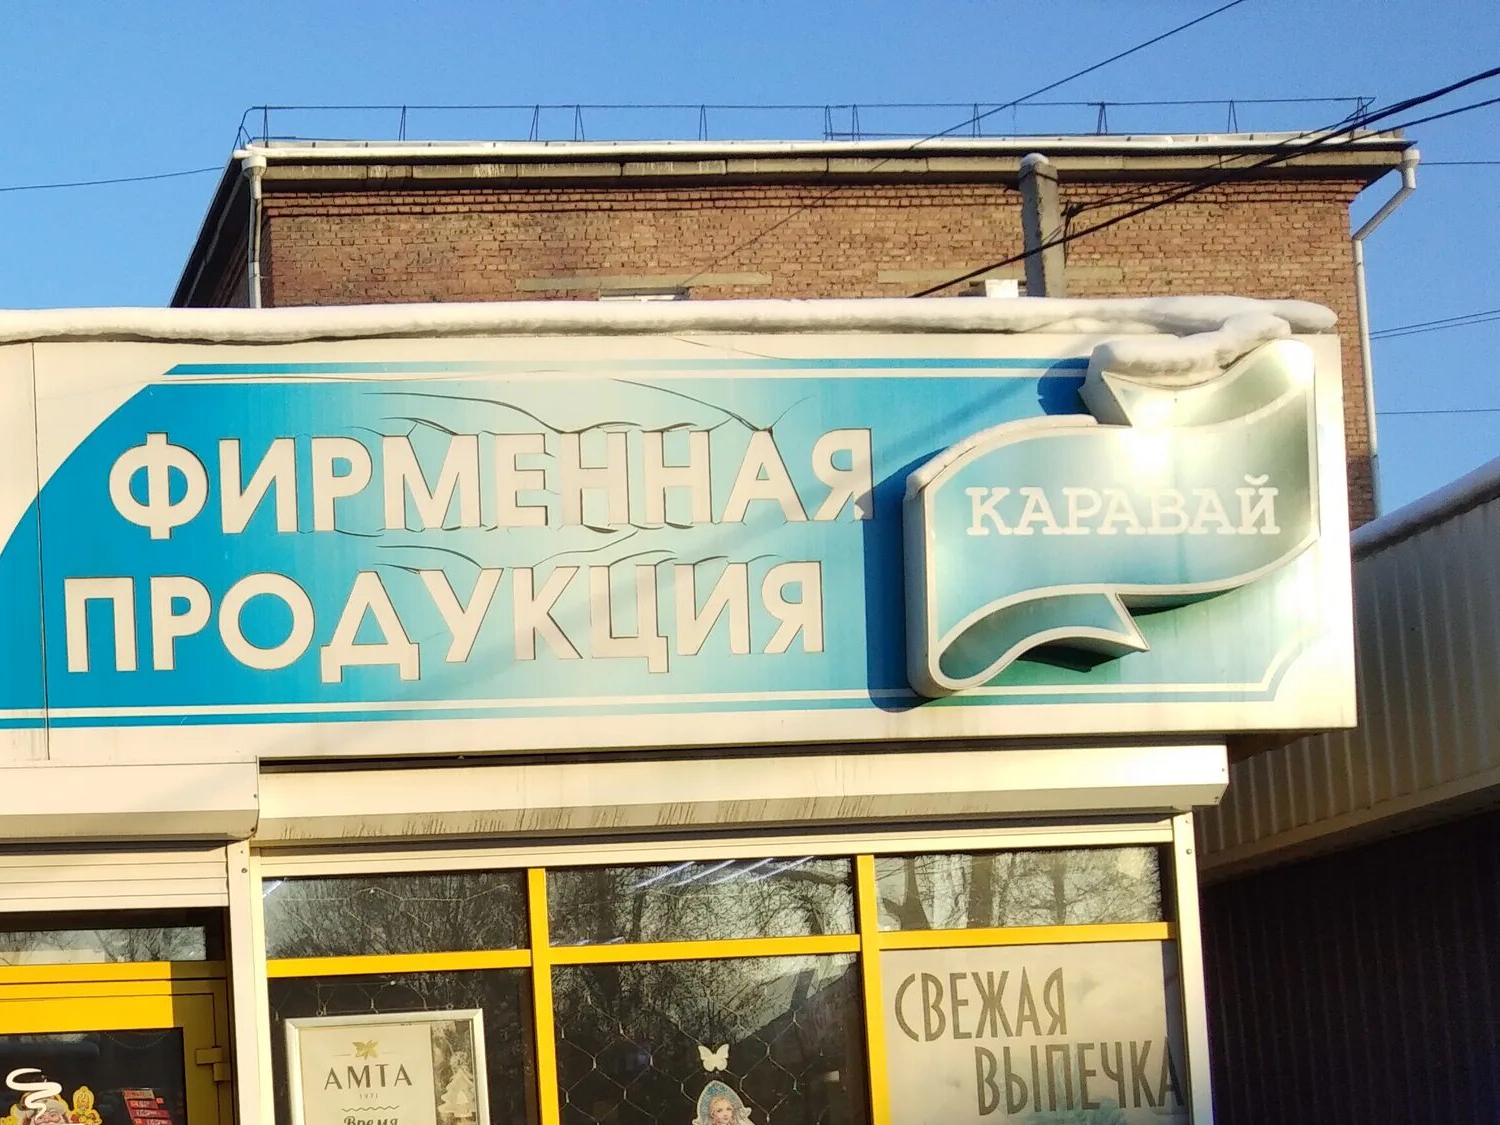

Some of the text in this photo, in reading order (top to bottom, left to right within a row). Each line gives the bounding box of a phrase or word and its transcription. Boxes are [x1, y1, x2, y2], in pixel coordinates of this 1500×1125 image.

[108, 427, 875, 540] ФИРМЕННАЯ
[965, 473, 1281, 537] КАРАВАЙ
[63, 560, 825, 683] ПРОДУКЦИЯ
[894, 966, 1067, 1042] СВЕЖАЯ
[324, 1063, 413, 1090] АМТА
[974, 1036, 1184, 1116] ВЫПЕЧКА
